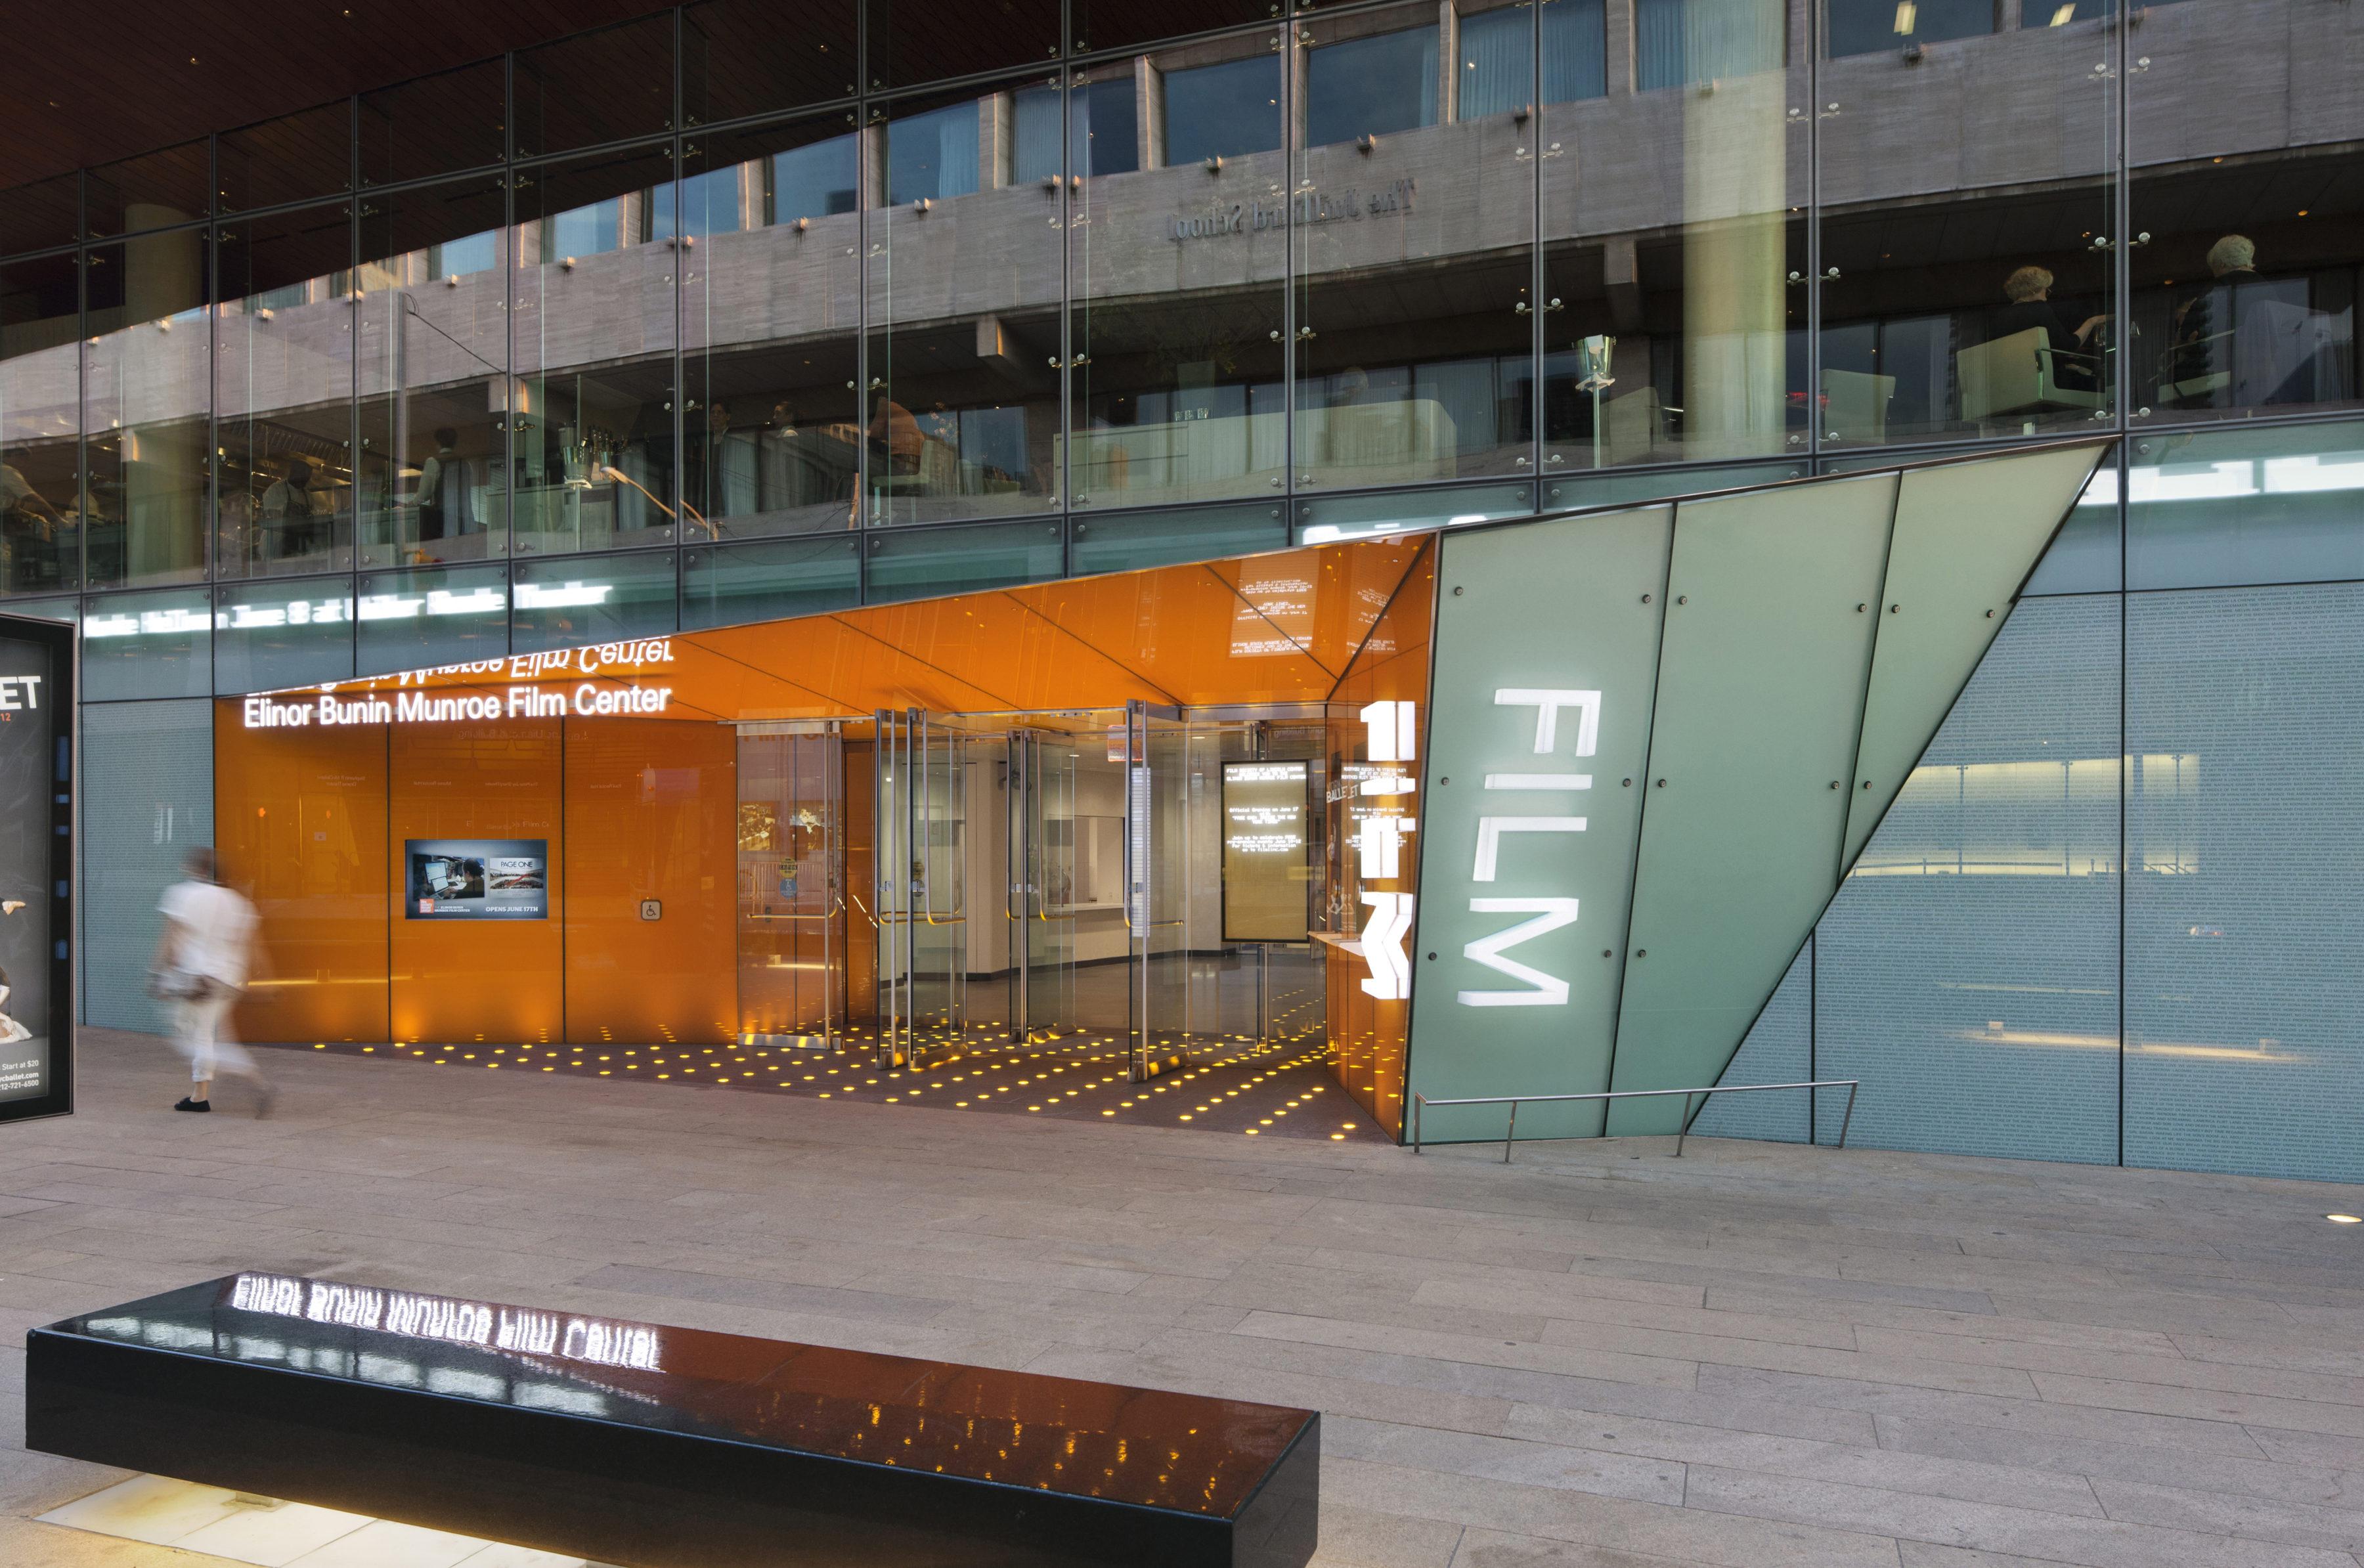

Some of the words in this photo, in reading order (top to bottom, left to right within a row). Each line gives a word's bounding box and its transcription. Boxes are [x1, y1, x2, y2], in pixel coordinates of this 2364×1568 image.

[287, 601, 310, 624] 8
[246, 693, 312, 727] Elinor
[320, 695, 389, 724] Bunin
[399, 693, 499, 721] Munroe
[510, 687, 565, 717] Film
[575, 685, 670, 714] Center
[1457, 688, 1602, 1007] FILM
